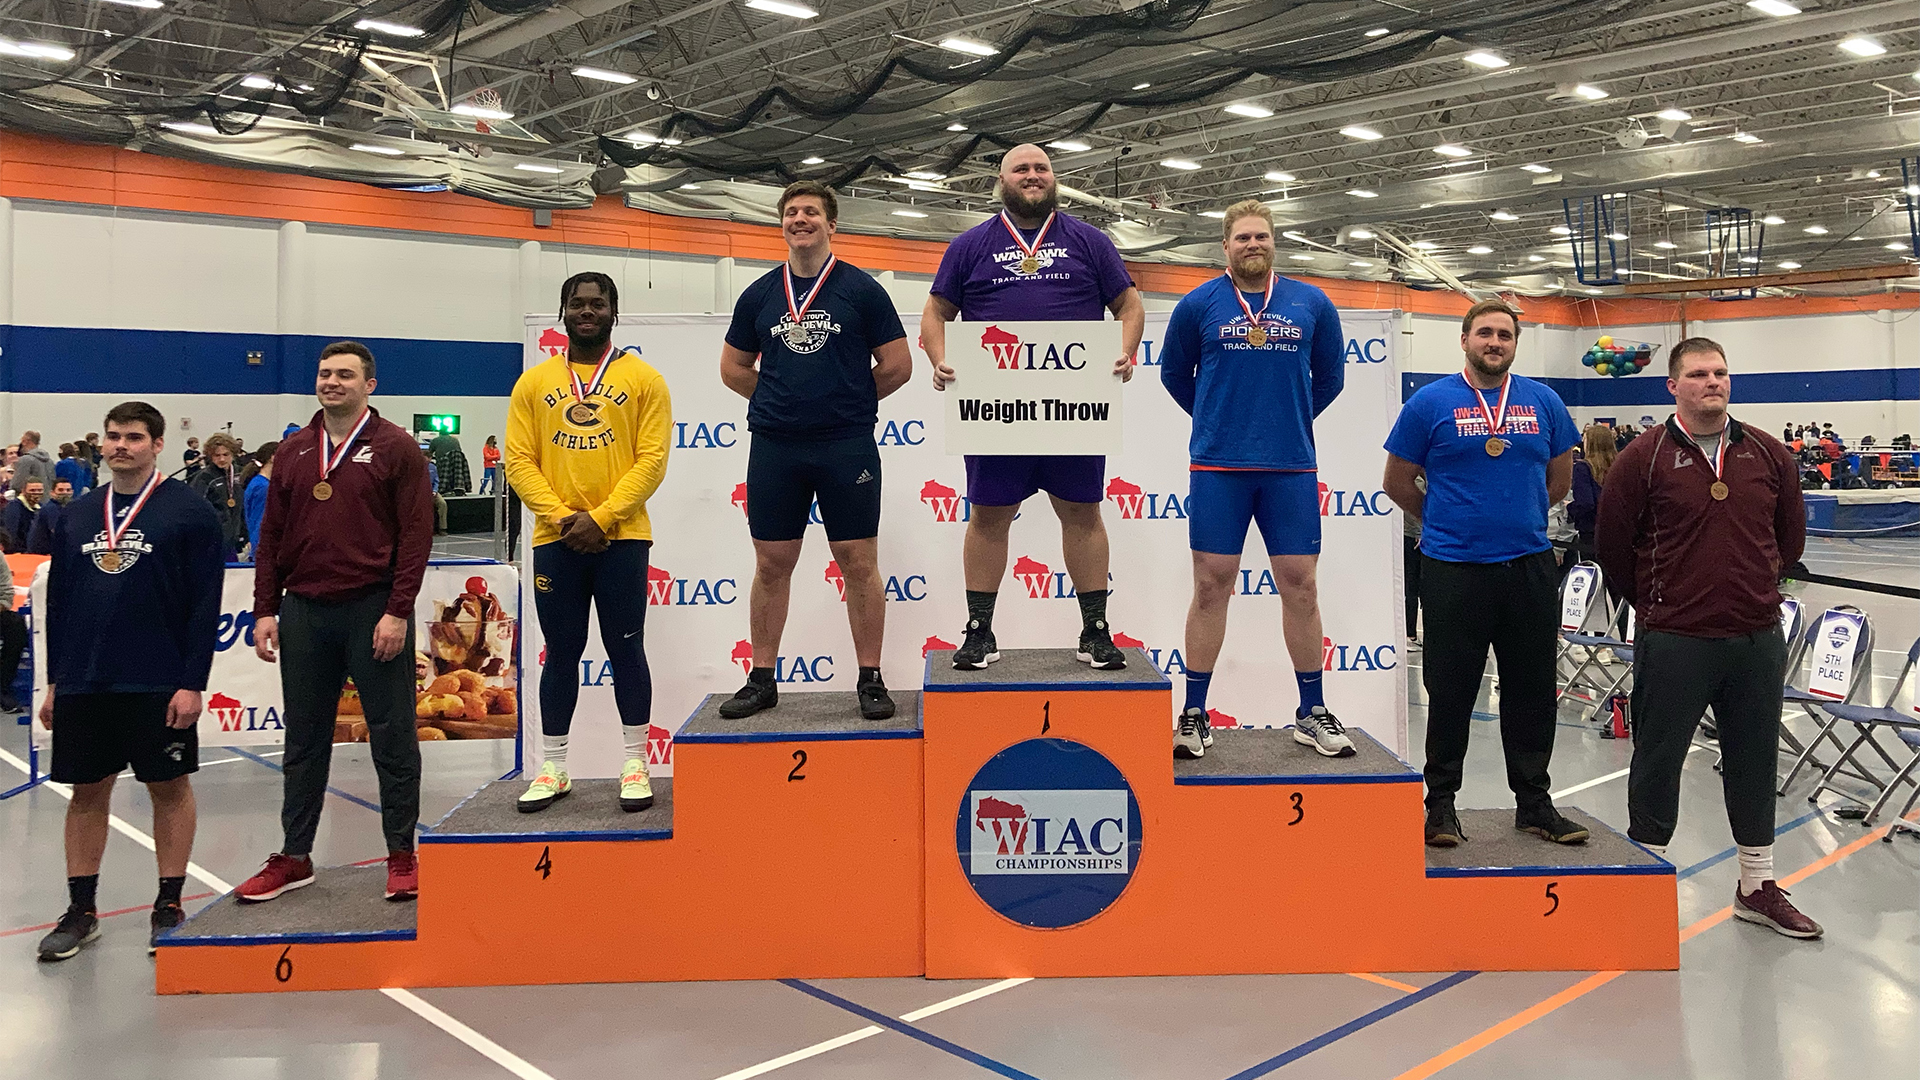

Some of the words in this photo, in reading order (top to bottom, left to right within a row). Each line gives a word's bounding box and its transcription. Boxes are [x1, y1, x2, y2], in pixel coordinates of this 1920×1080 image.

[992, 248, 1069, 263] WARAWK
[992, 276, 1020, 285] TRACK
[802, 320, 841, 334] DEVILS
[1221, 326, 1300, 339] PIOERS
[985, 341, 1087, 371] WIAC
[1223, 342, 1252, 351] TRACK
[1275, 343, 1298, 352] FIELD
[1344, 338, 1387, 364] AC
[544, 383, 629, 409] BLUOLD
[959, 399, 1037, 424] Weight
[1042, 399, 1110, 421] Throw
[675, 421, 737, 449] IAC
[878, 420, 926, 446] AC
[1456, 422, 1492, 437] TRAC
[1566, 608, 1582, 618] PLACE
[1824, 653, 1842, 666] 5TH
[1818, 667, 1844, 682] PLACE
[210, 706, 285, 732] WIA
[1041, 700, 1051, 736] 1
[787, 749, 808, 782] 2
[1287, 792, 1304, 826] 3
[977, 816, 1124, 856] WIAC
[534, 845, 552, 880] 4
[995, 858, 1123, 870] CHAMPIONSHIPS
[1543, 881, 1560, 917] 5
[275, 945, 293, 983] 6
